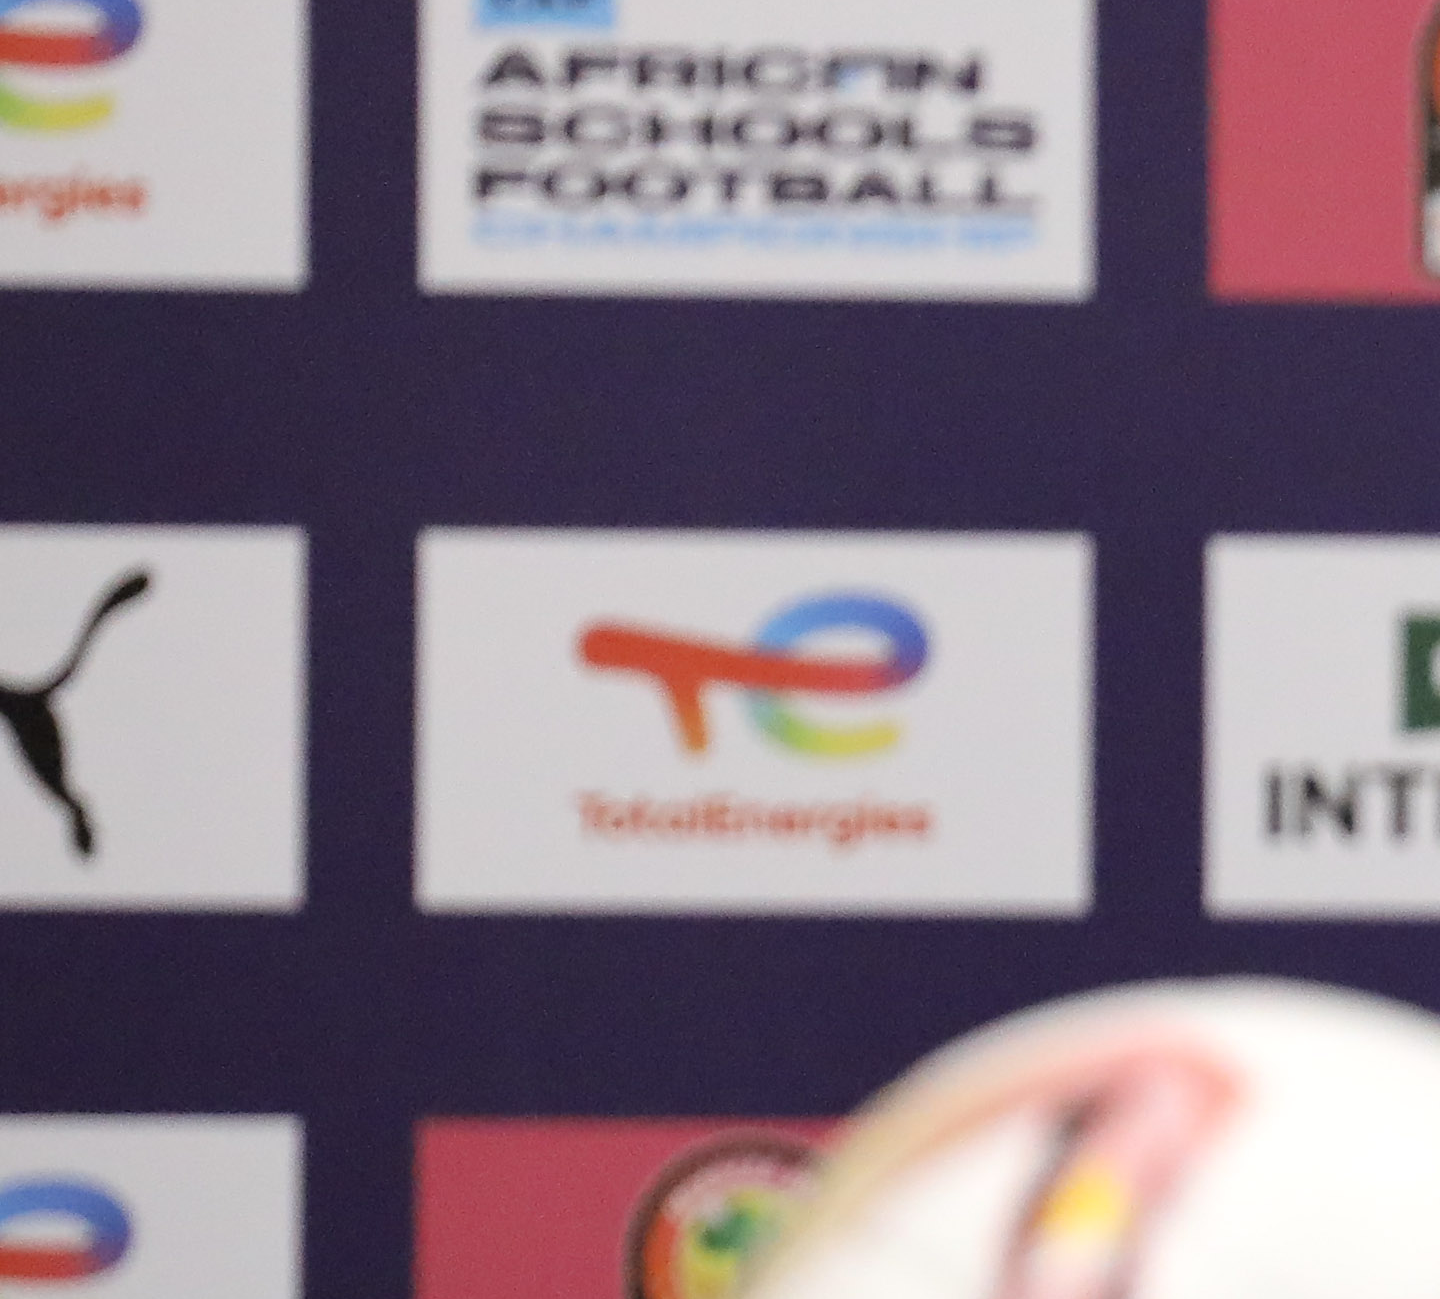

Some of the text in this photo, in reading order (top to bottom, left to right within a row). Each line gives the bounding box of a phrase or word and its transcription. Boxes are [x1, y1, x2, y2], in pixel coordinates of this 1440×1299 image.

[482, 48, 985, 95] AFRICAN
[477, 109, 1037, 153] SCHOOLS
[475, 163, 1038, 213] FOOTBALL
